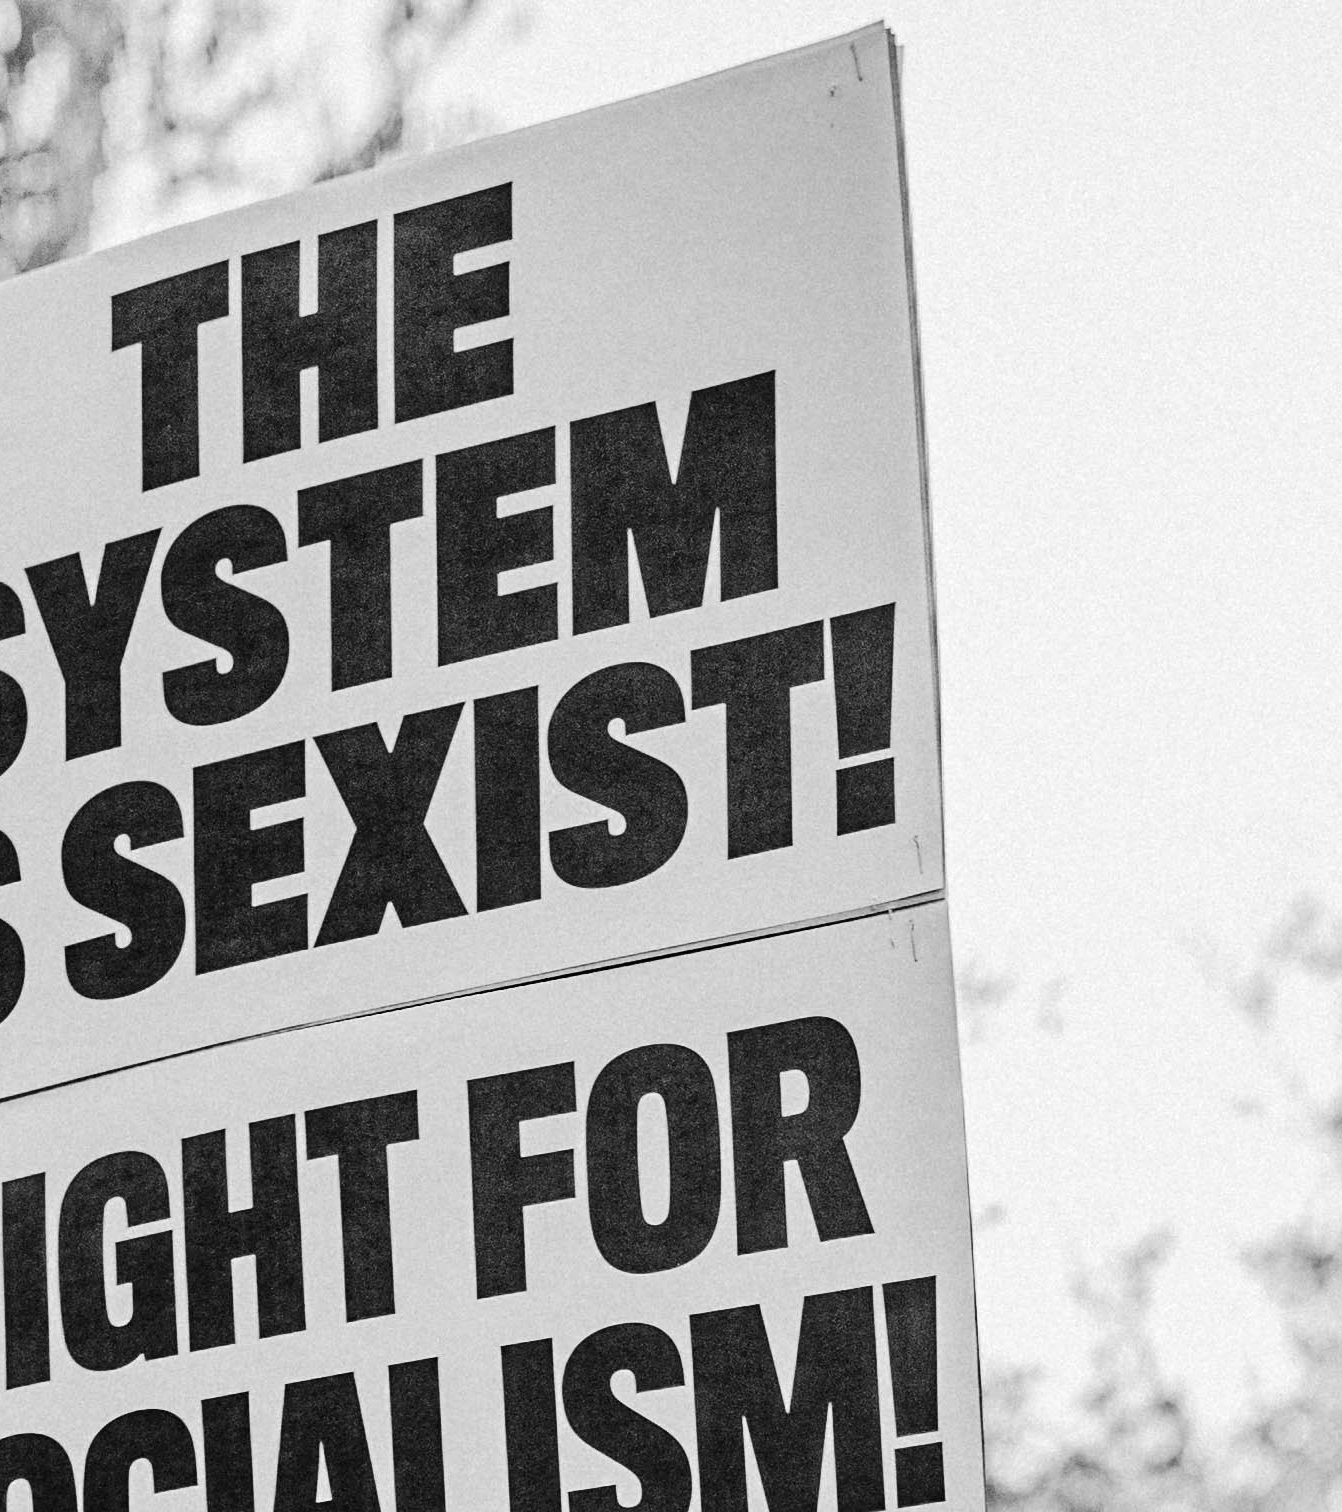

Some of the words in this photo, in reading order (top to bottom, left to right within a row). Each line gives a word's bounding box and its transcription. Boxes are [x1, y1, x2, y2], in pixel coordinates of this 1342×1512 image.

[112, 182, 513, 492] THE
[62, 603, 895, 999] SEXIST!
[467, 1017, 874, 1299] FOR
